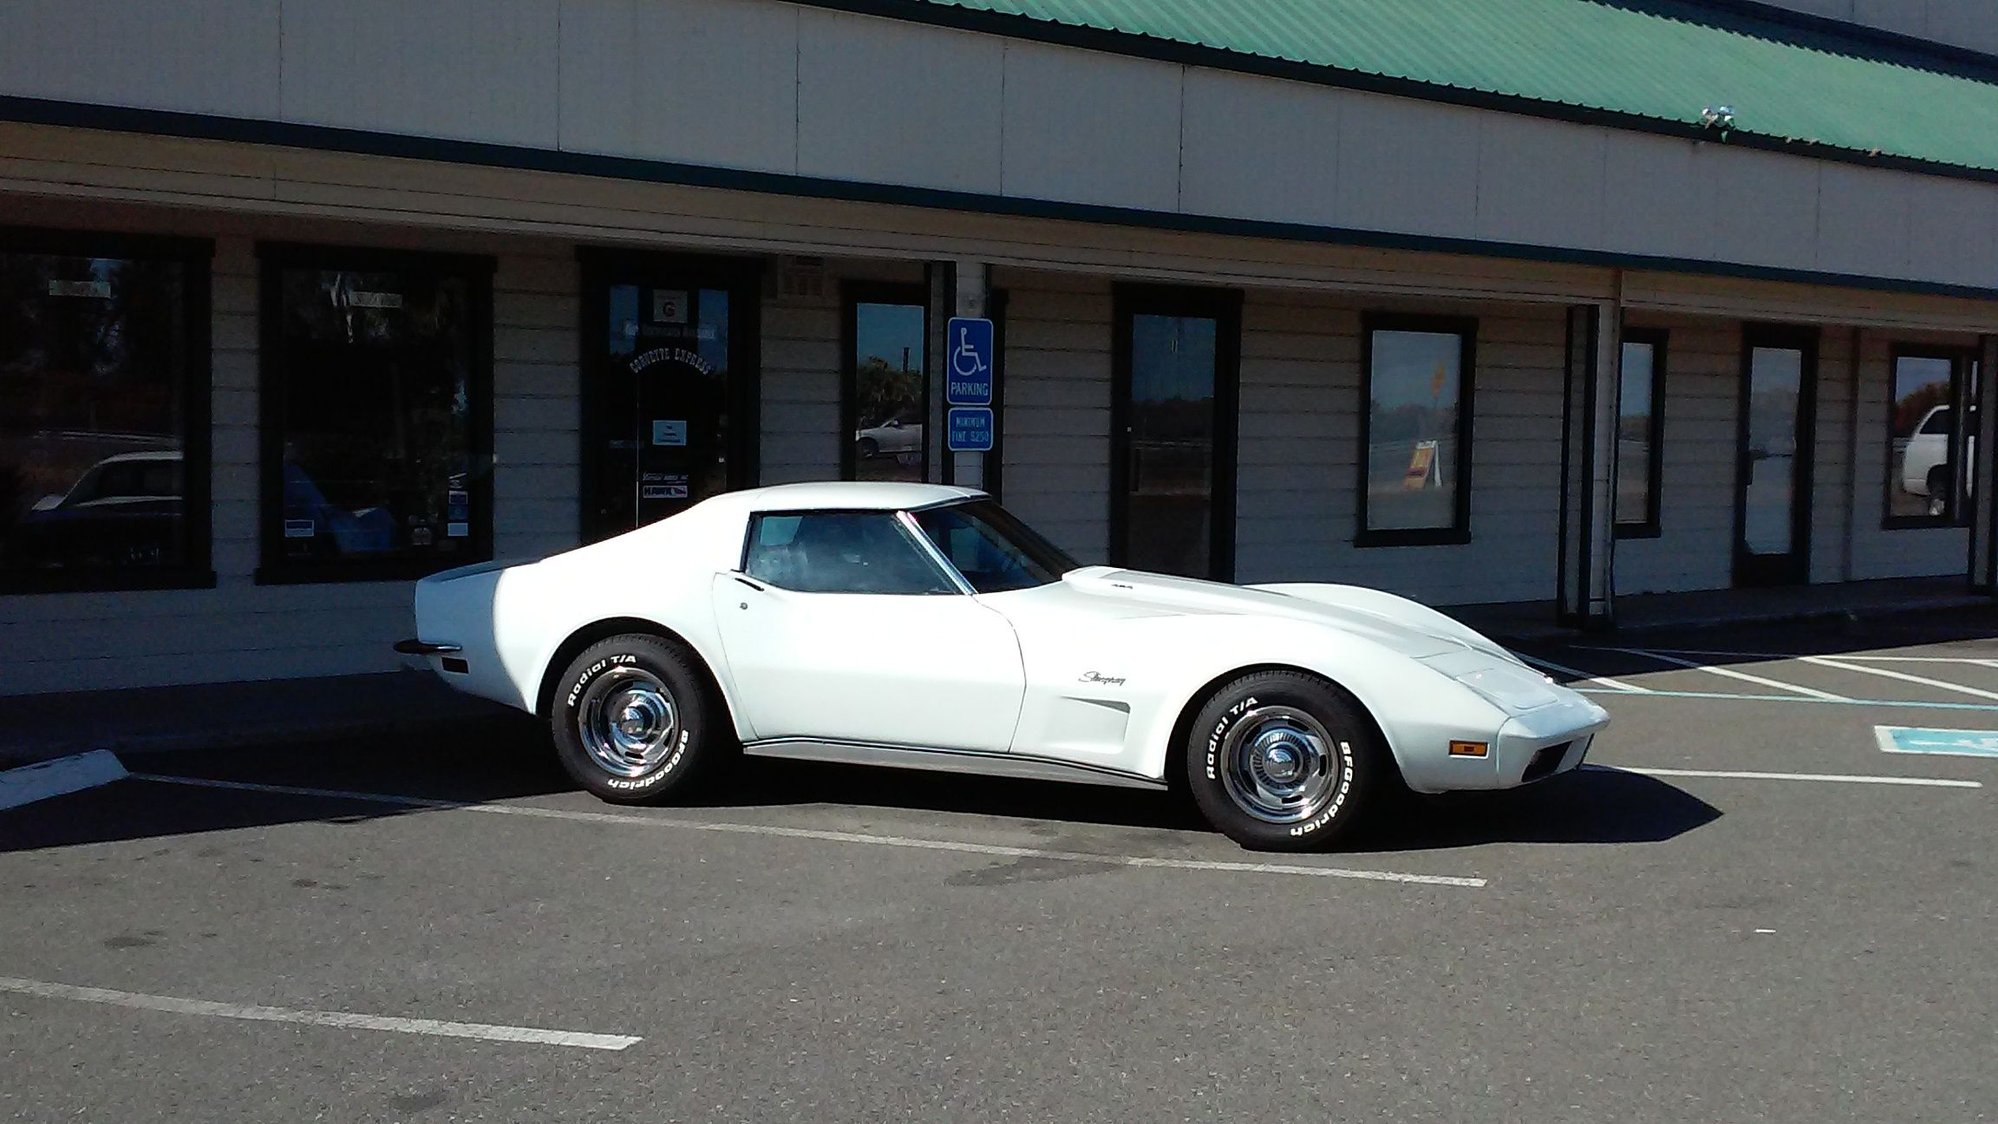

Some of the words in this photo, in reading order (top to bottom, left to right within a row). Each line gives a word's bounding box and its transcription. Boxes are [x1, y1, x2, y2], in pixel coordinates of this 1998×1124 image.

[674, 347, 714, 376] EXPRESS
[950, 381, 989, 396] PARKING
[955, 416, 986, 428] MINIMUM
[951, 430, 967, 443] FINE
[969, 430, 989, 443] $250
[566, 659, 607, 707] Radial
[609, 654, 637, 665] T/A
[1078, 670, 1127, 686] Stingray
[1204, 715, 1229, 780] Radial
[1229, 696, 1259, 716] T/A
[1290, 741, 1354, 838] BFGoodrich
